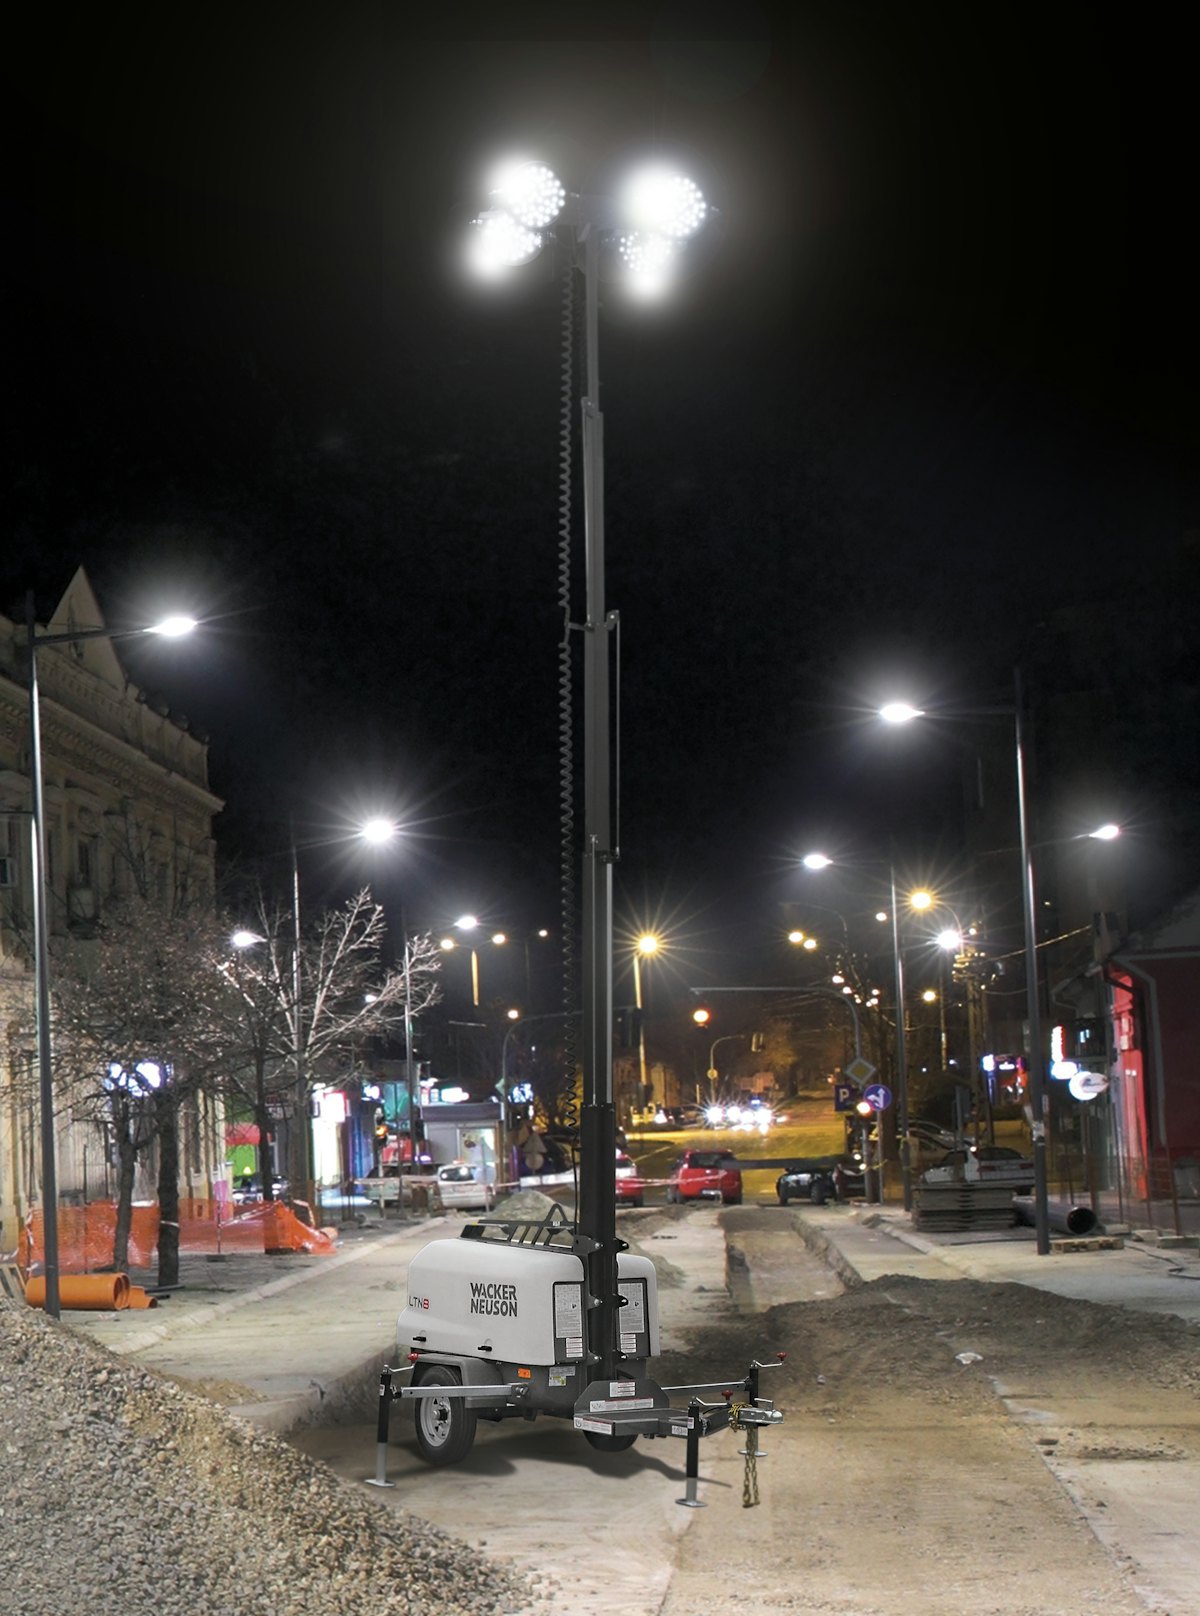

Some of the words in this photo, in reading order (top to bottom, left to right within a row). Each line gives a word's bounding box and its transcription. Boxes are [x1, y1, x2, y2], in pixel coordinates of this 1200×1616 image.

[470, 1283, 517, 1301] WACKER
[409, 1296, 430, 1310] LTN8
[470, 1299, 518, 1317] NEUSON
